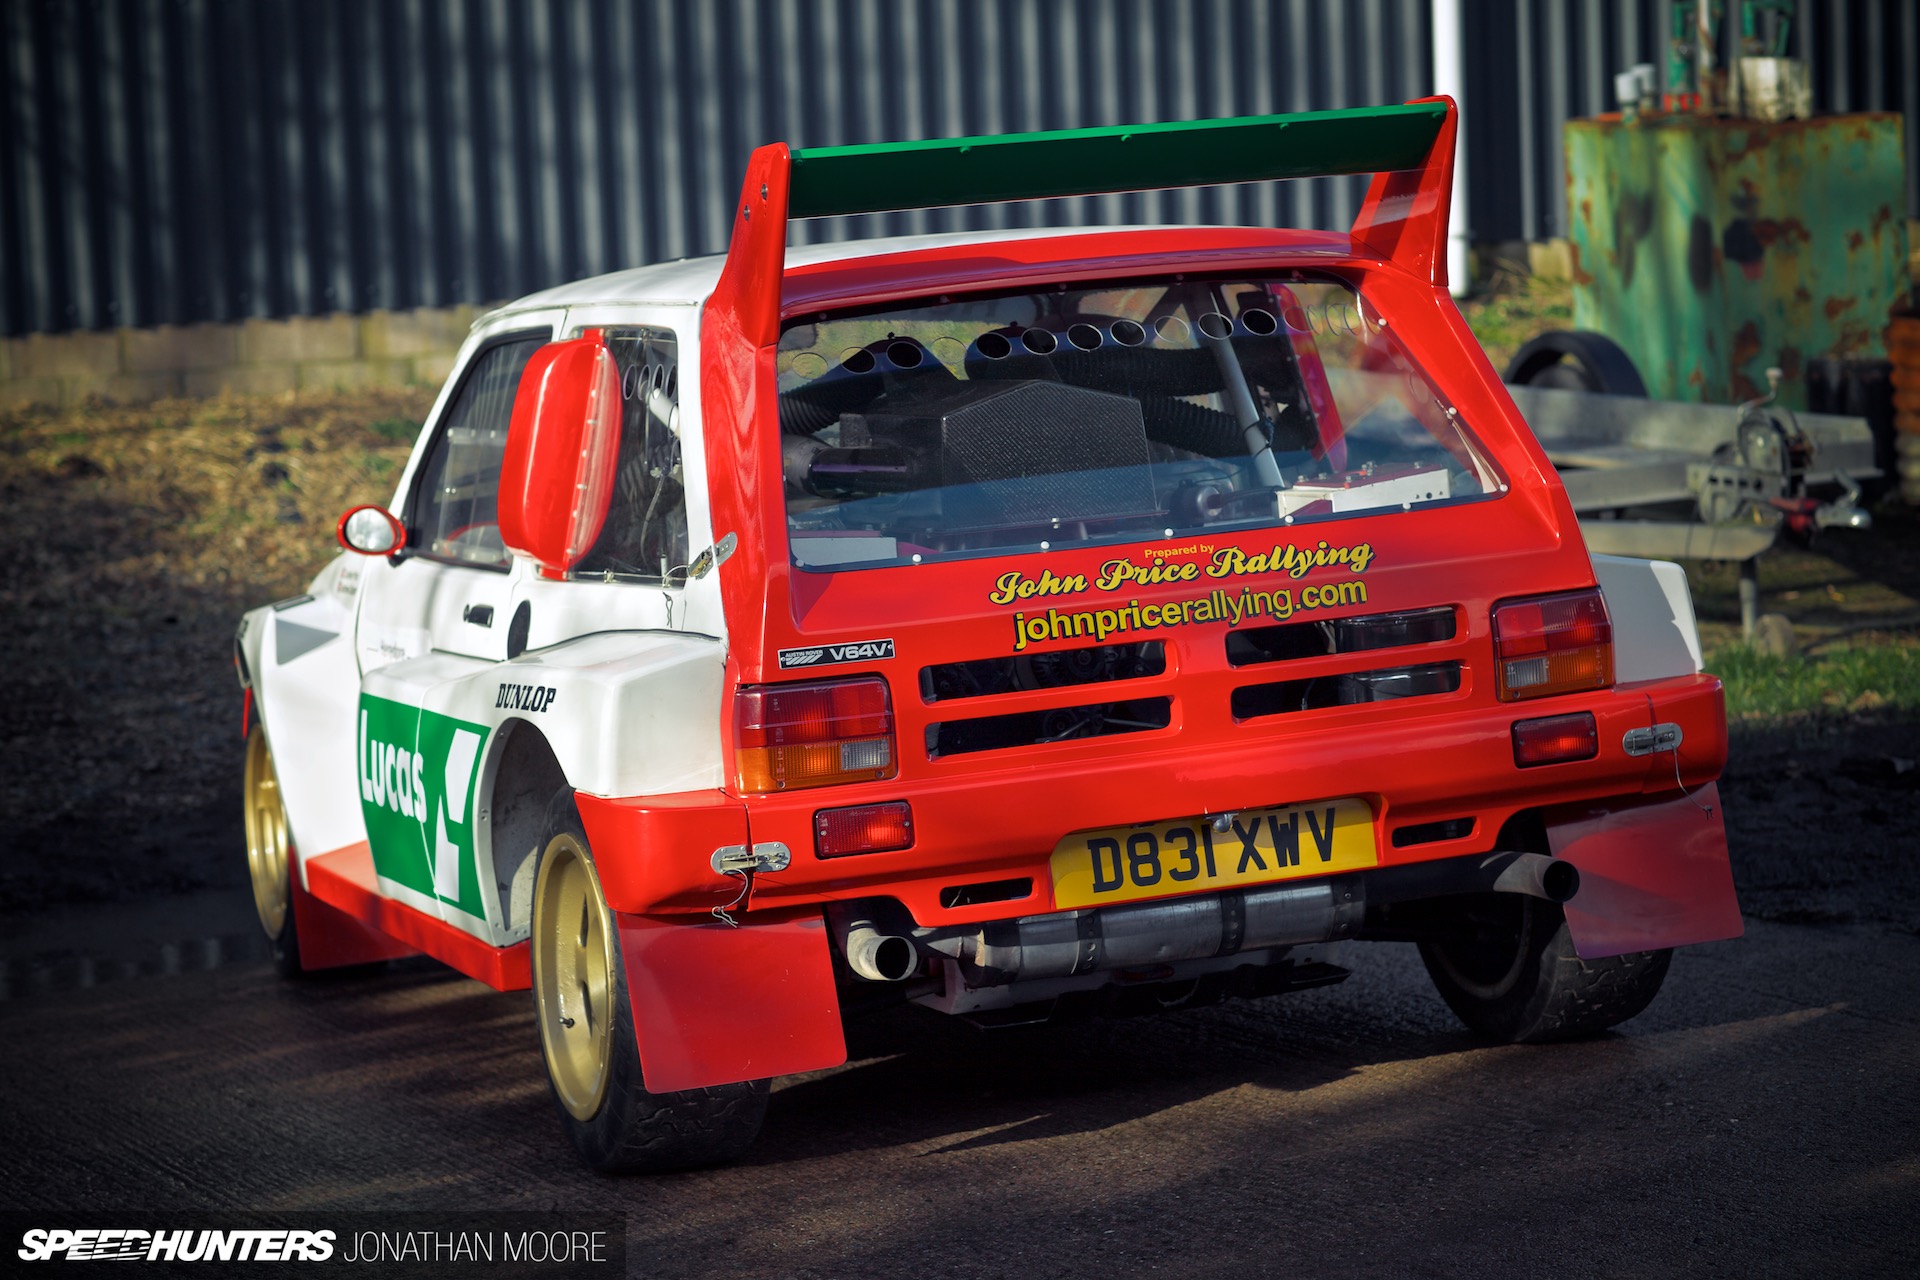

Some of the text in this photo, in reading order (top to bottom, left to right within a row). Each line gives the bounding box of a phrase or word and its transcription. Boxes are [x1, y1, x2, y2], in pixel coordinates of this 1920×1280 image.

[989, 540, 1374, 605] John Price Rallying
[1144, 544, 1214, 558] Prepared by
[1013, 579, 1368, 652] johnpricerallying.com
[829, 643, 887, 660] V64V
[495, 683, 556, 713] DUNLOP
[361, 709, 427, 823] Lucas
[1087, 808, 1335, 893] D831 XWV
